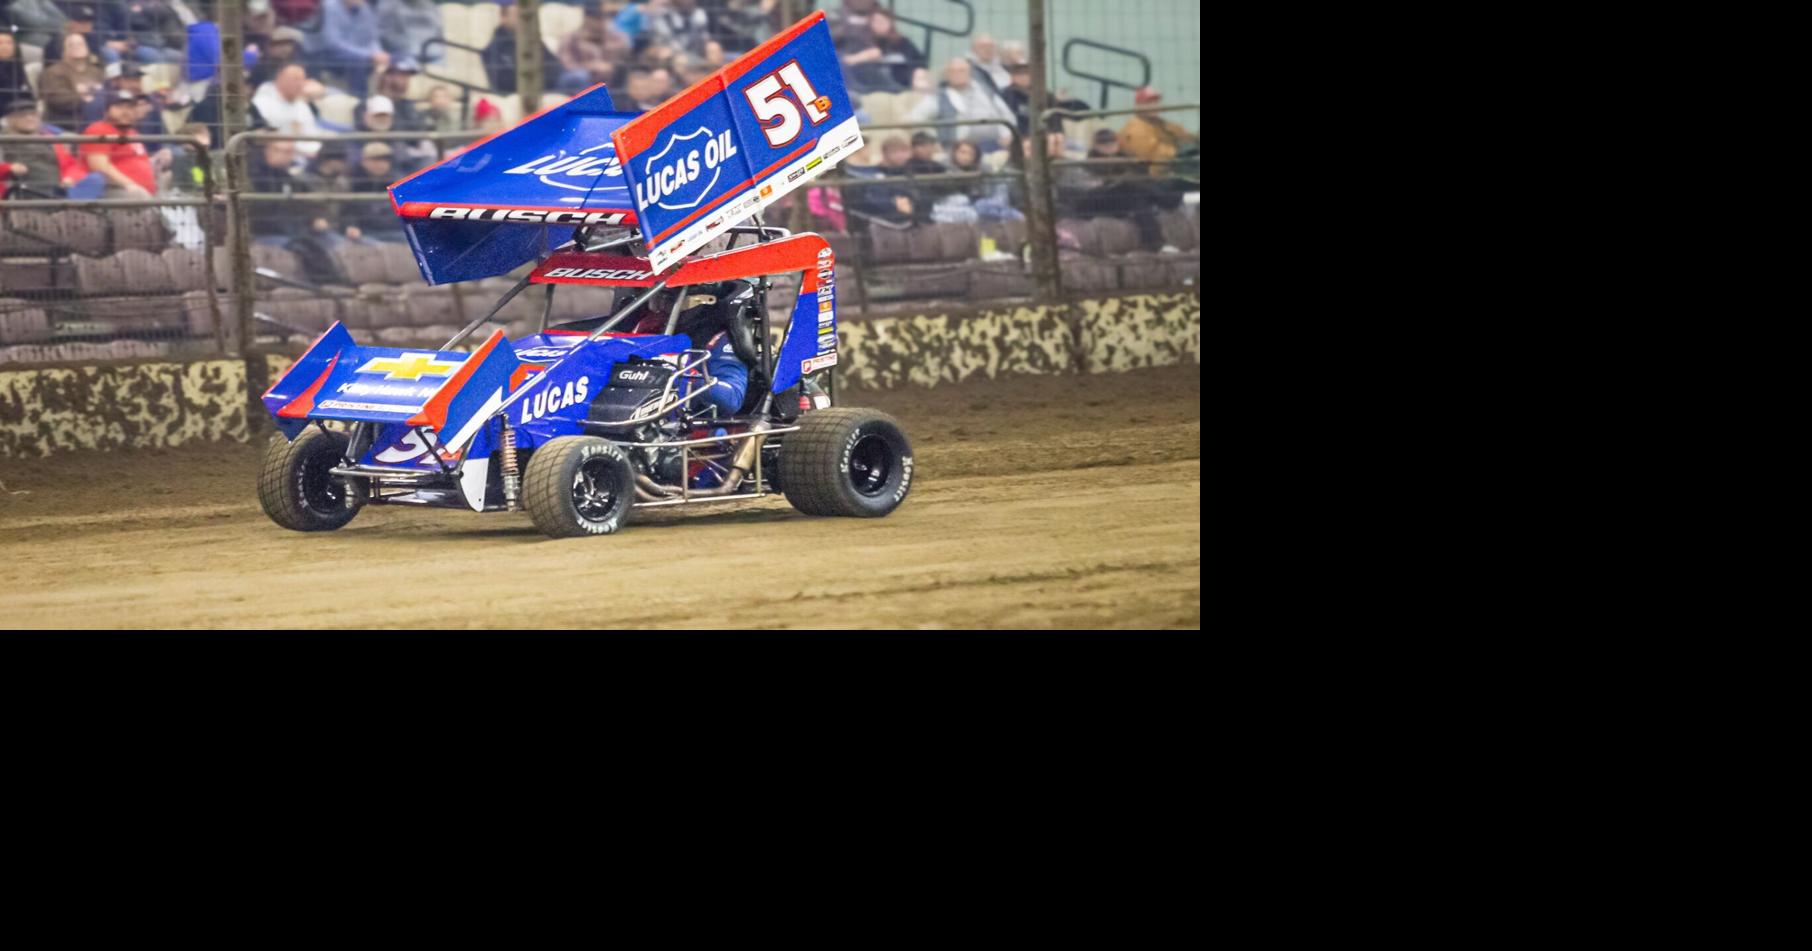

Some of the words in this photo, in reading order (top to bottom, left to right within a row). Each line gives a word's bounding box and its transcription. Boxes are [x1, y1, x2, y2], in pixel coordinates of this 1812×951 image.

[635, 152, 700, 212] LUCAS
[704, 129, 737, 172] OIL
[430, 207, 627, 225] BUSCH
[544, 268, 654, 280] BUSCH
[619, 370, 649, 380] Guhl
[521, 375, 590, 424] LUCAS
